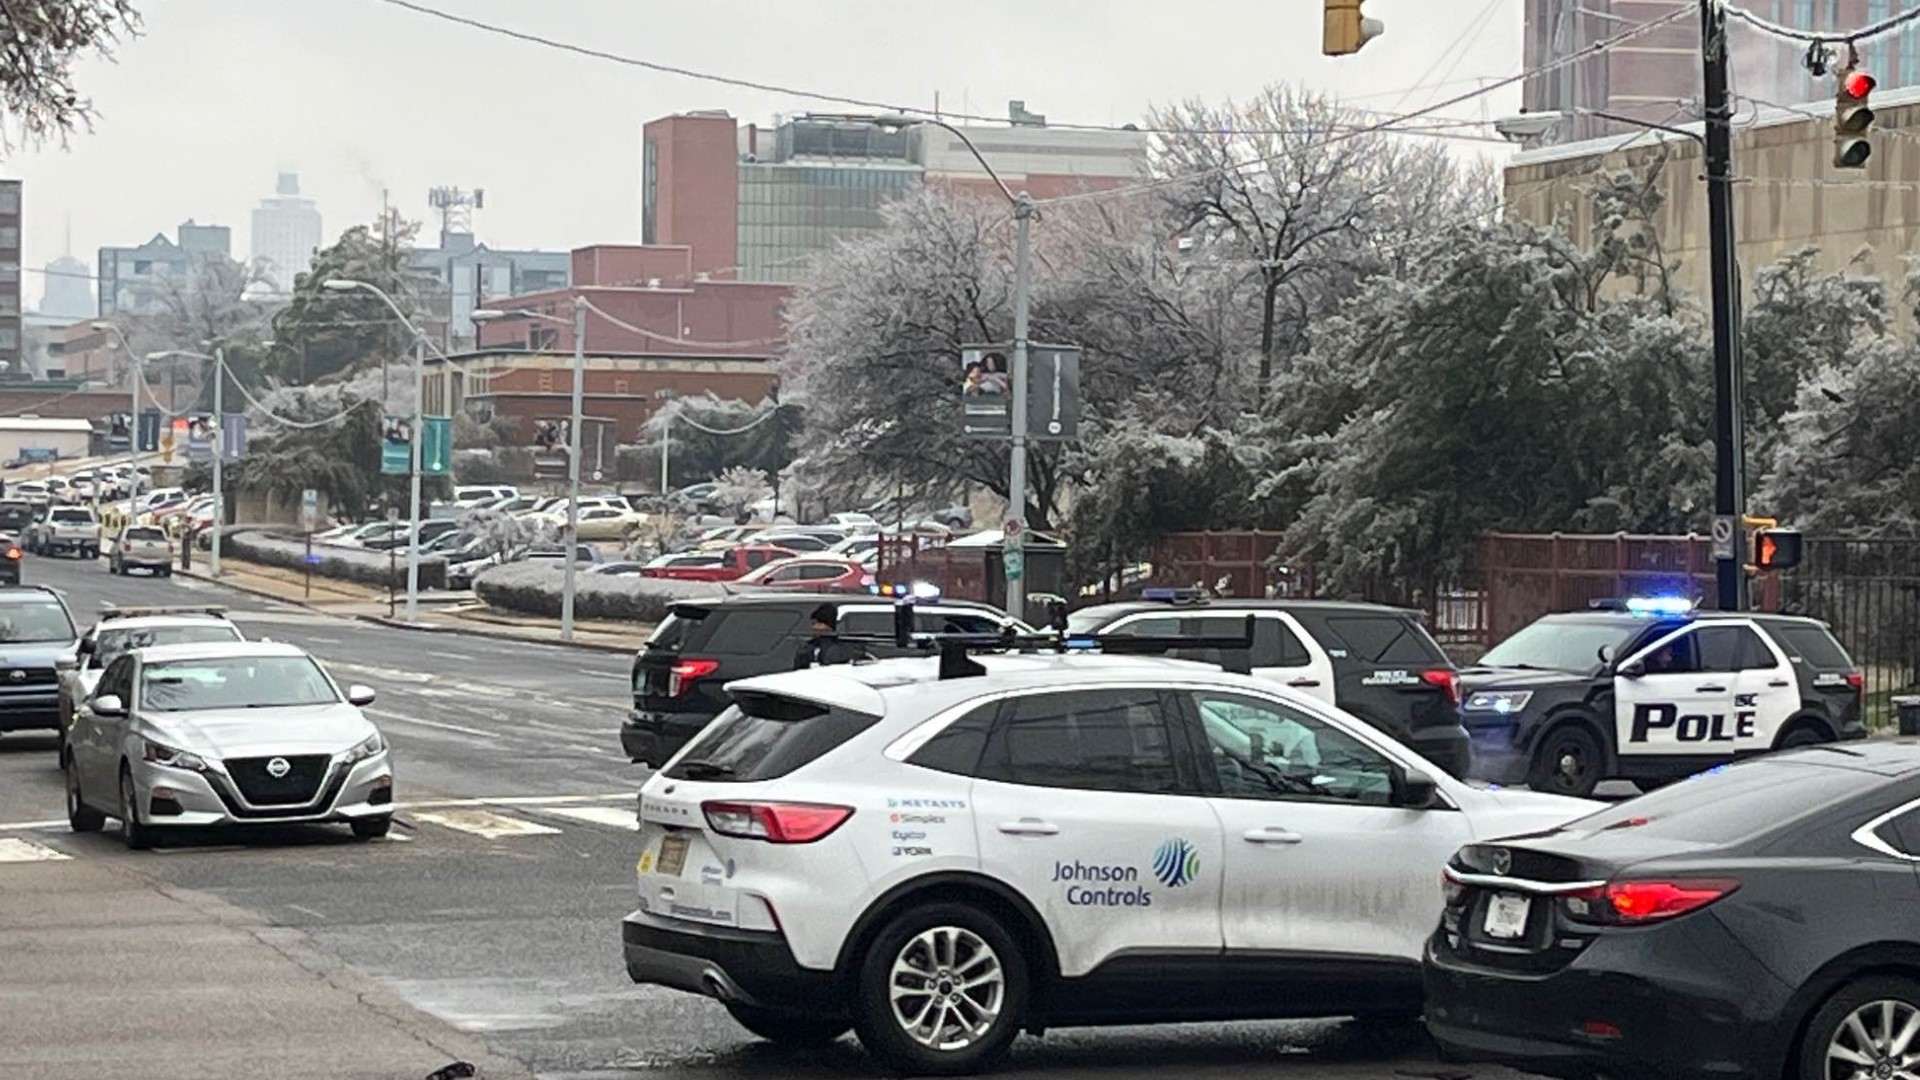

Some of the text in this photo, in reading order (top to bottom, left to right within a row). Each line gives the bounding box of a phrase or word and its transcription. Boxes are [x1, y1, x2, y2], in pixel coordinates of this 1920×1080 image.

[901, 799, 966, 808] METASYS
[1051, 860, 1138, 882] Johnson
[1067, 885, 1152, 907] Controls
